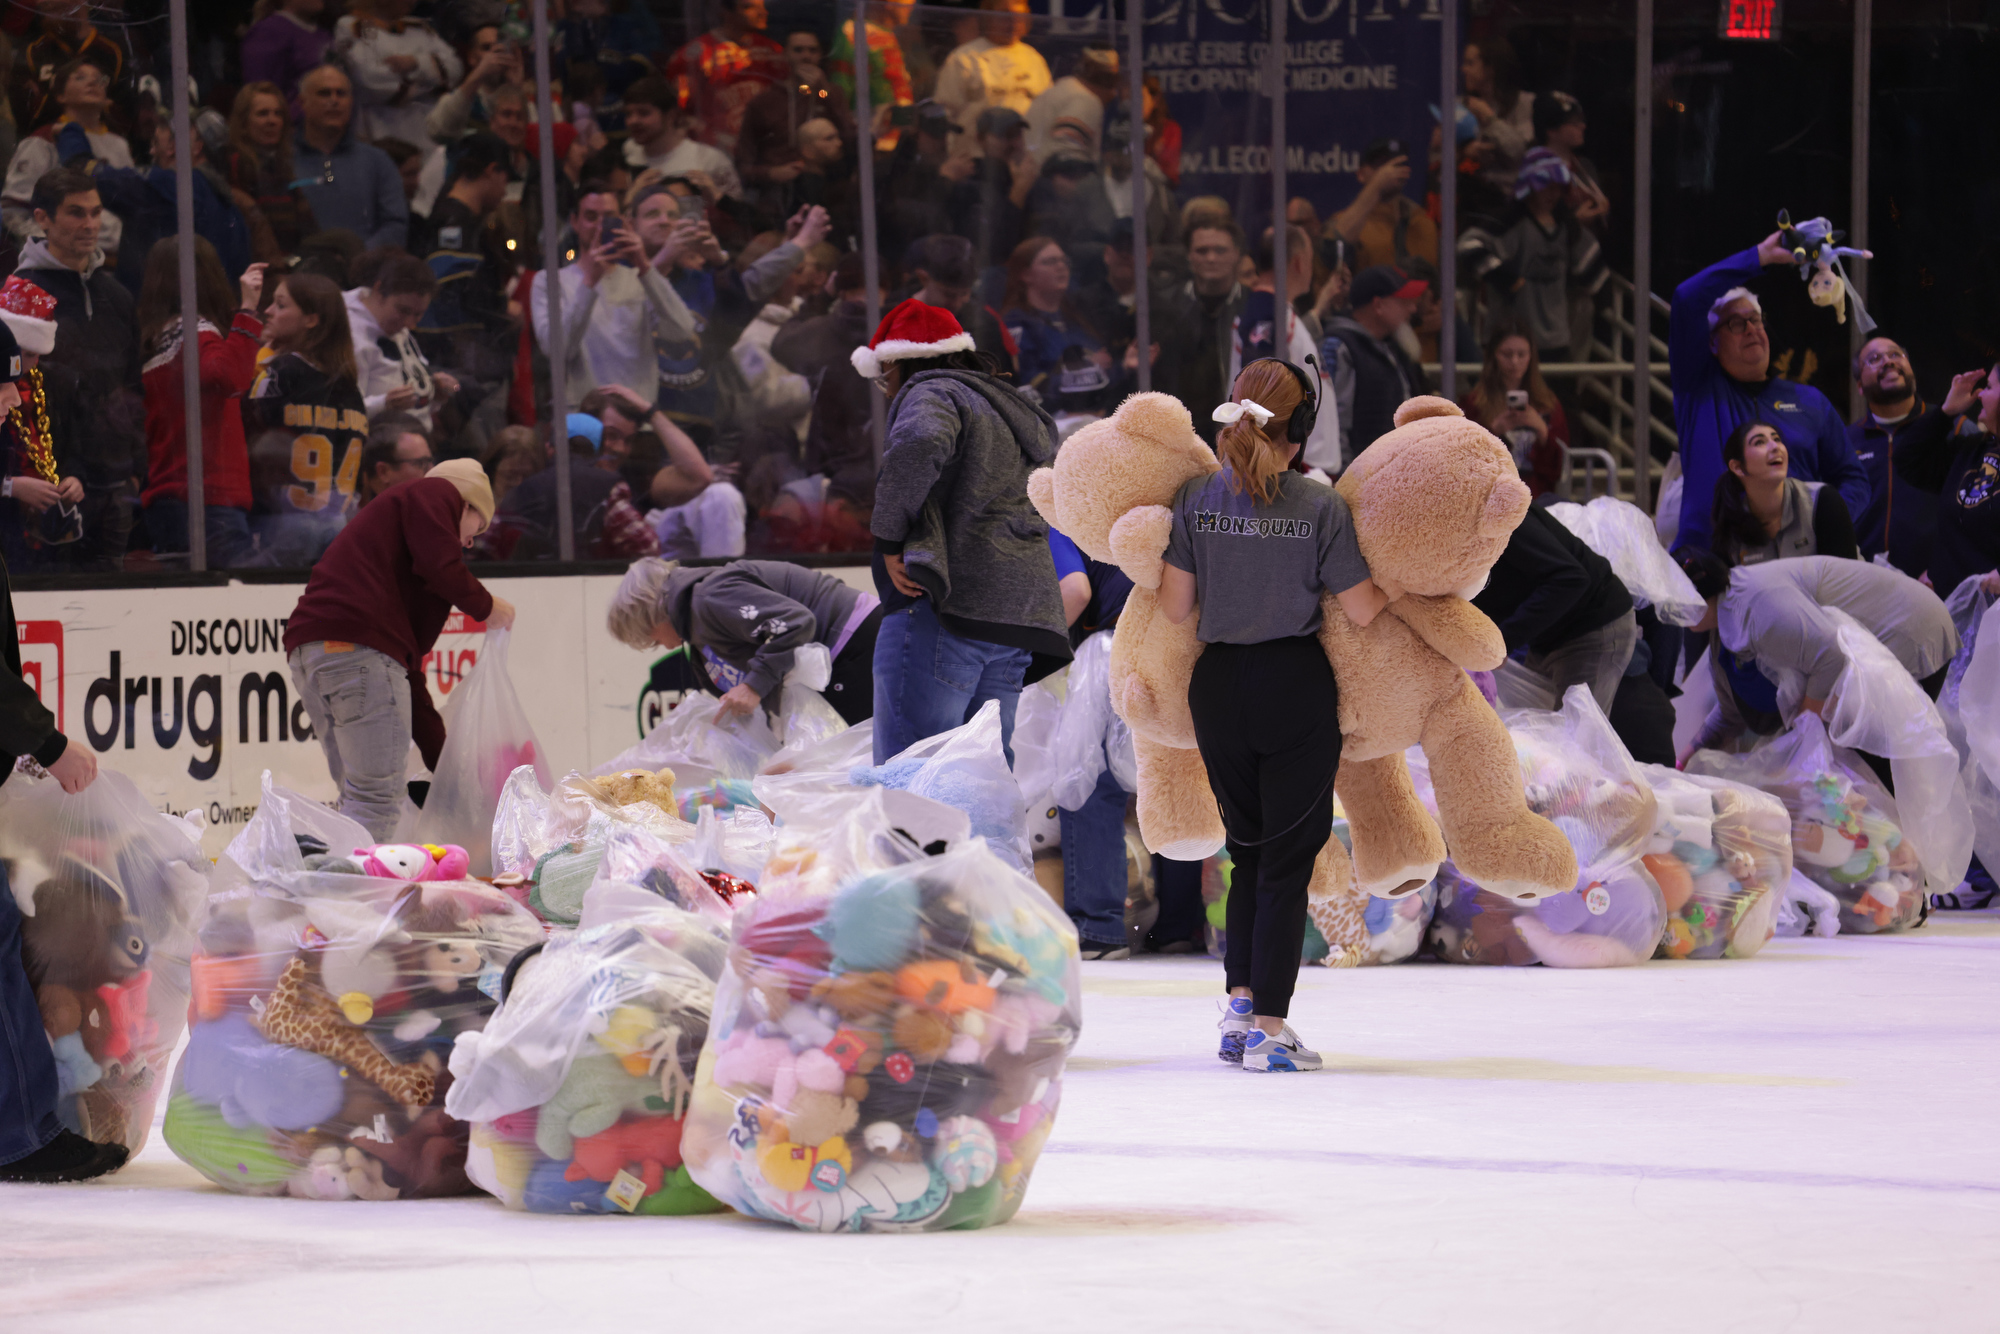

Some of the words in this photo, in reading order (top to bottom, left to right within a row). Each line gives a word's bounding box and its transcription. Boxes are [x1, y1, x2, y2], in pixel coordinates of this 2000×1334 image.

[1727, 0, 1776, 39] EXIT
[1142, 42, 1193, 66] AKE
[287, 434, 362, 513] 94
[1194, 509, 1313, 538] MONSQUAD
[84, 650, 222, 780] drug
[239, 671, 318, 743] ma
